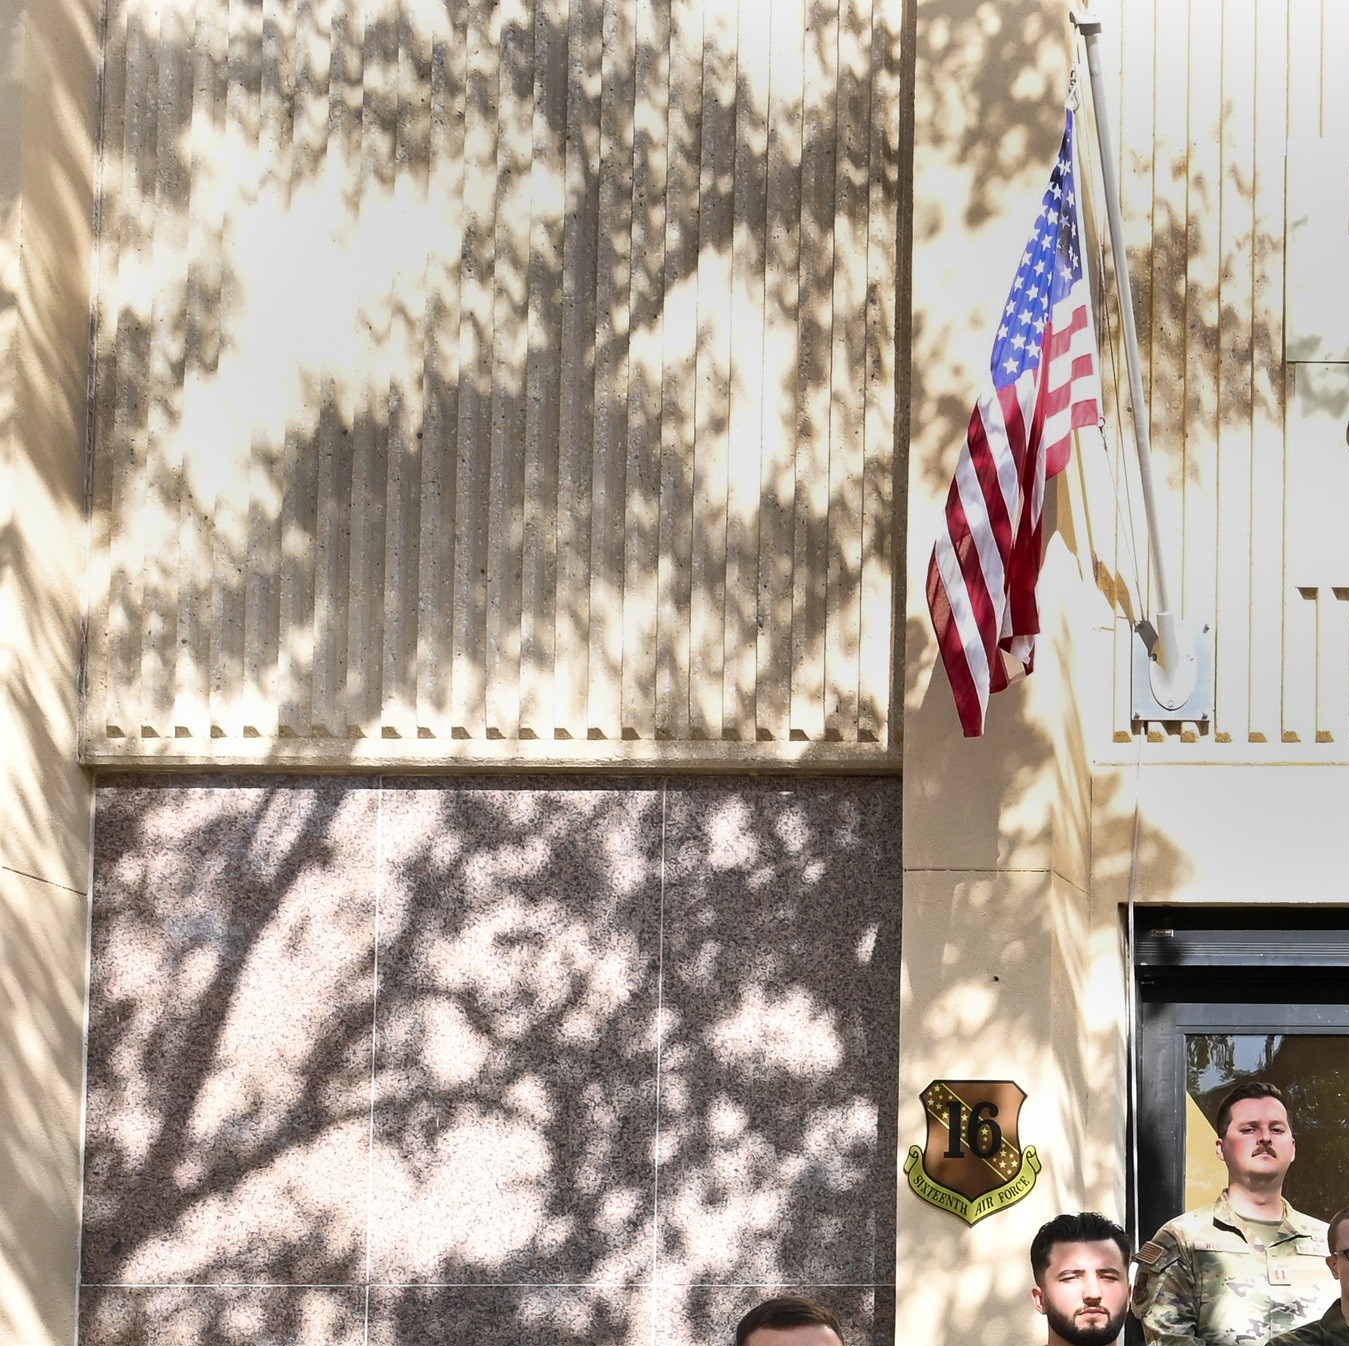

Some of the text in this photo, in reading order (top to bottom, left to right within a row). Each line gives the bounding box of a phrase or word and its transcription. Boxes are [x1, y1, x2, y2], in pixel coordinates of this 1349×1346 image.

[943, 1100, 1002, 1159] 16
[913, 1174, 1030, 1216] SIXTEENTH AIR FORCE
